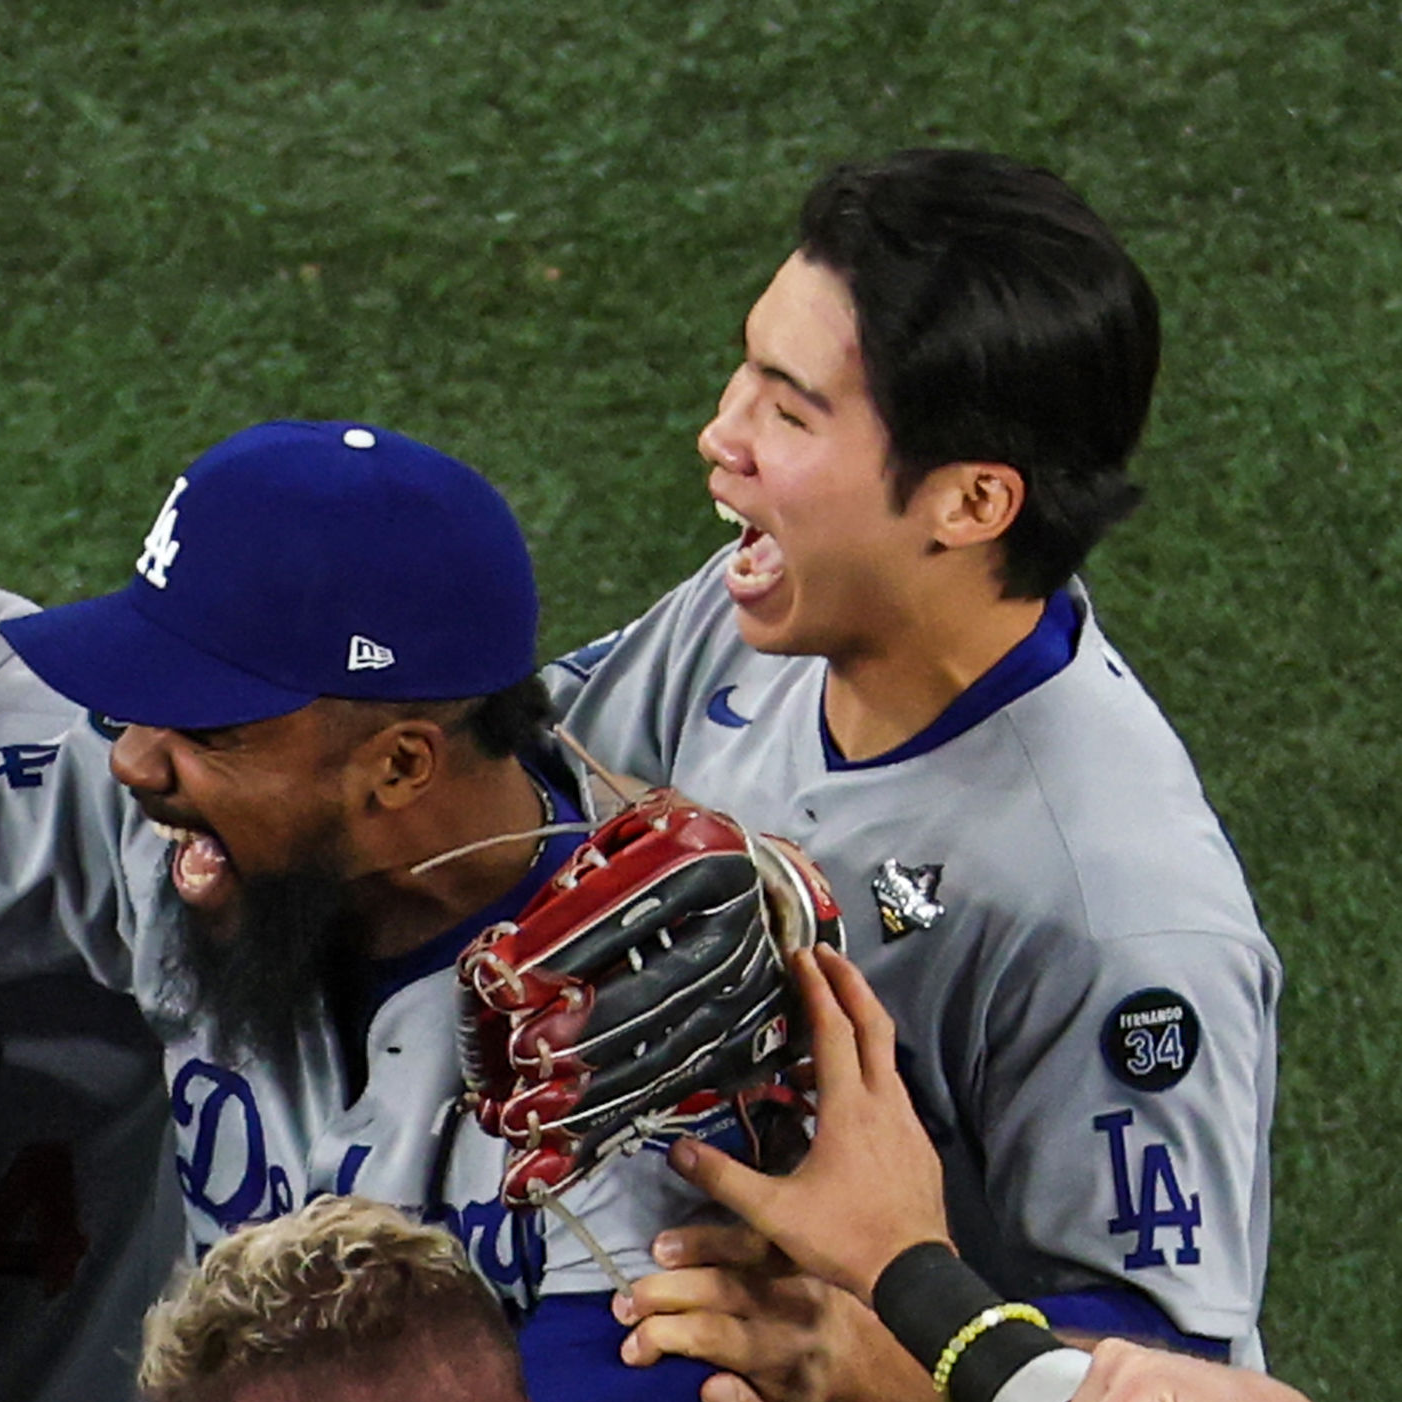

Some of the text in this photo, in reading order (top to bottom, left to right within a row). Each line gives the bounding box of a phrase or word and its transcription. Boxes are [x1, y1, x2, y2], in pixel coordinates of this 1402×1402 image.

[136, 476, 189, 589] LA
[1124, 1023, 1185, 1075] 34
[1094, 1109, 1201, 1271] LA
